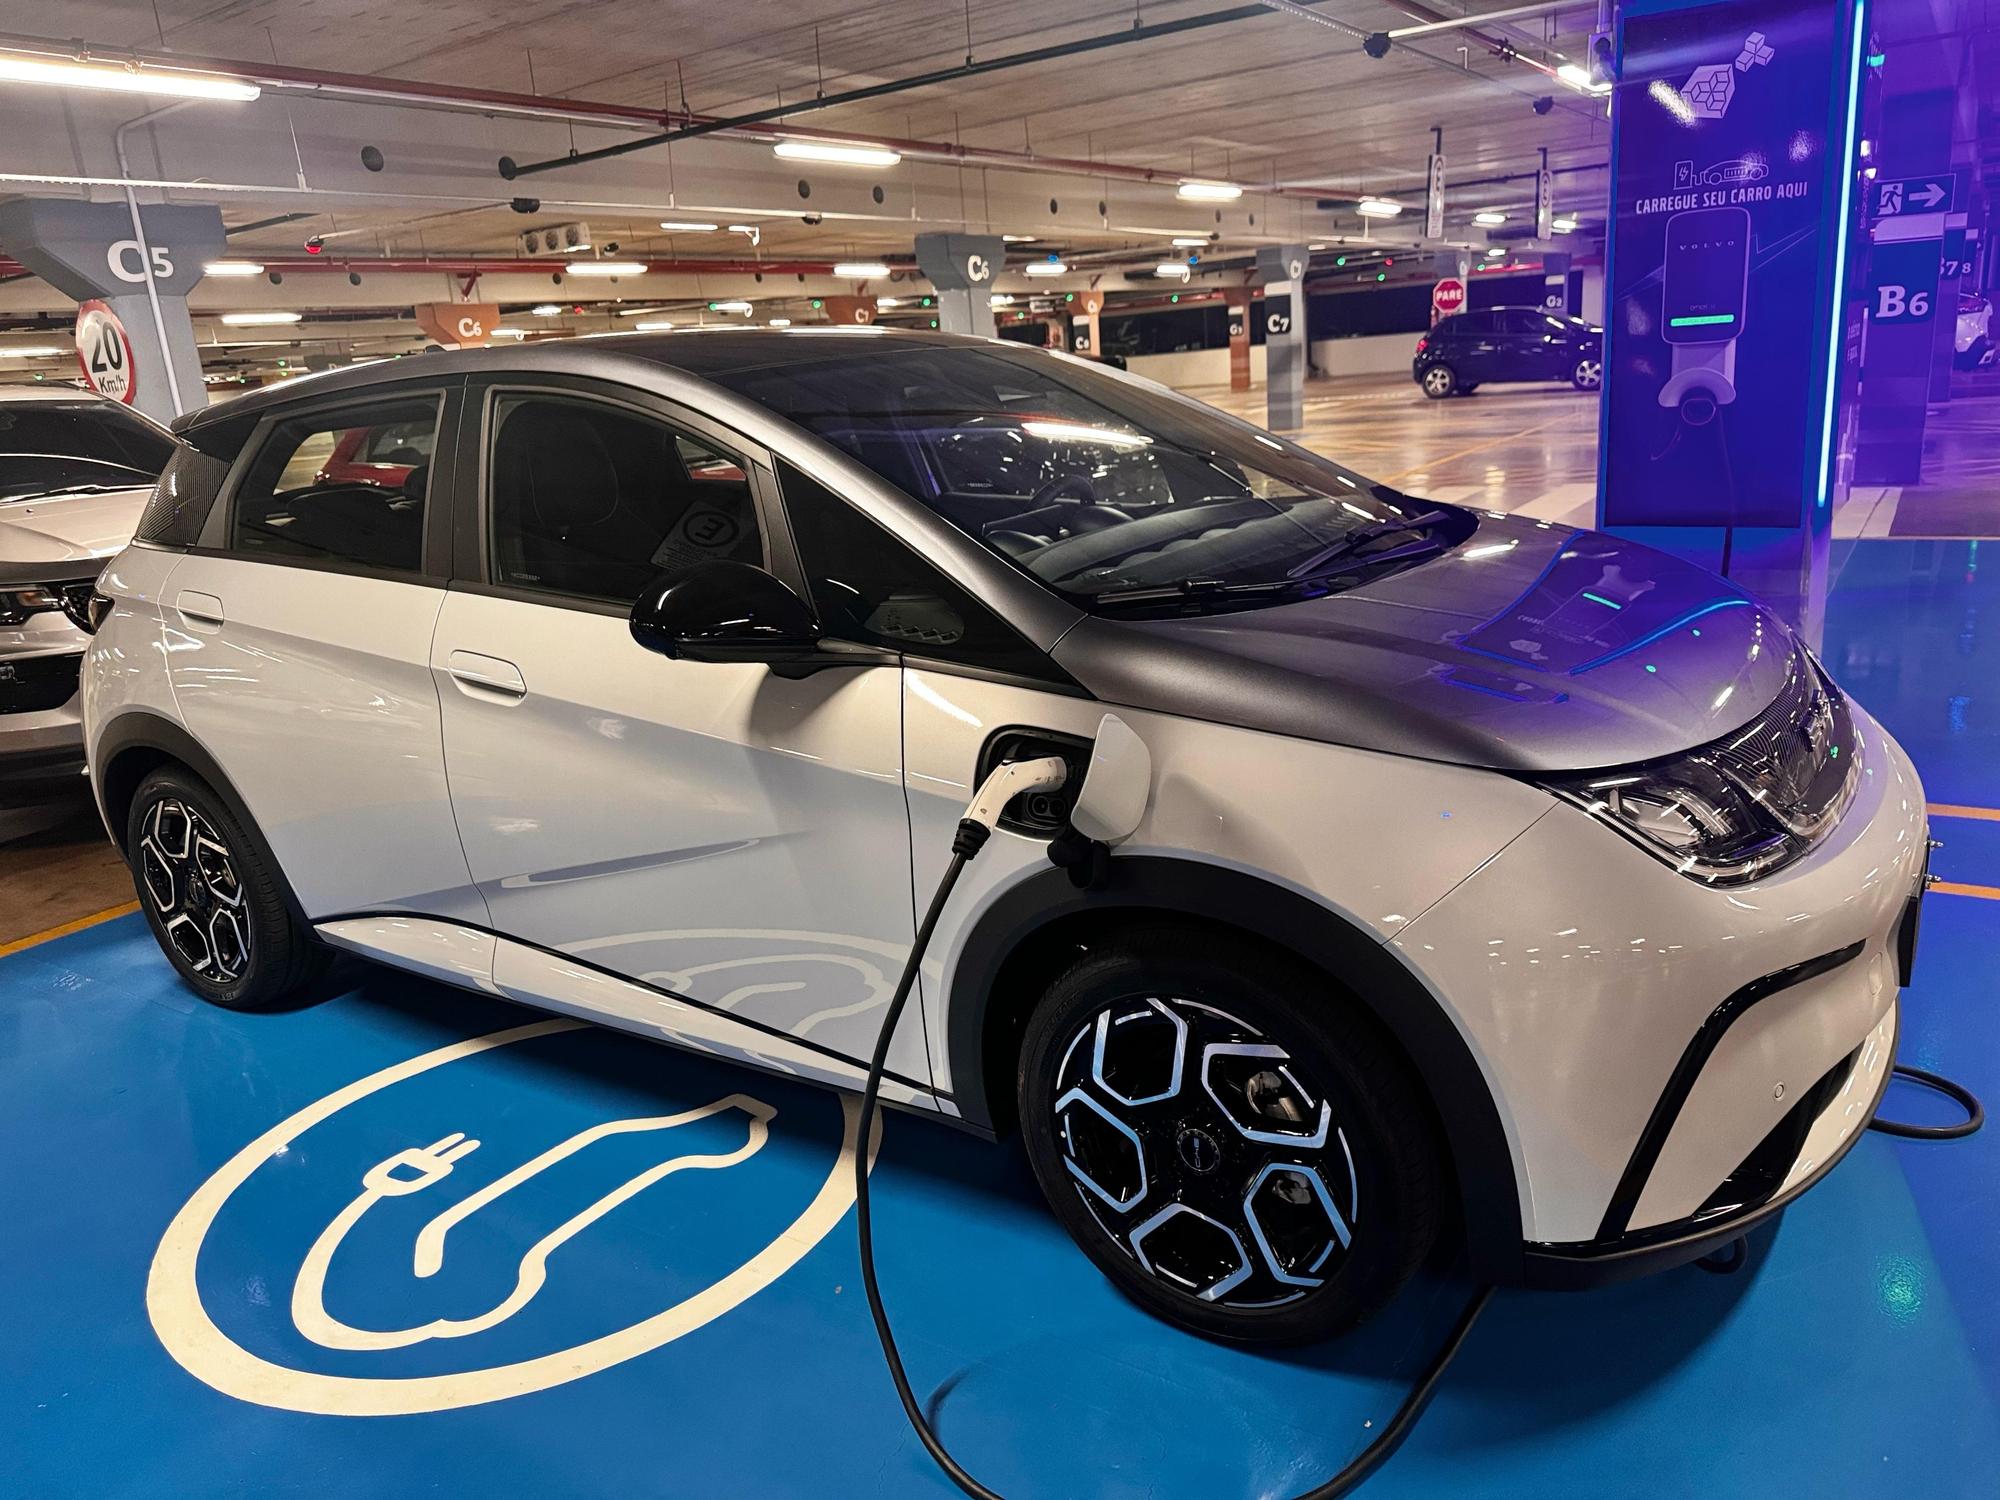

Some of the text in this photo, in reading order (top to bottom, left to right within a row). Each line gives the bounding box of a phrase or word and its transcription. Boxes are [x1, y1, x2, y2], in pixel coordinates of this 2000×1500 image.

[1636, 181, 1808, 215] CARREGUE SEU CARRO AQUI
[1679, 240, 1735, 250] VOLVO
[107, 239, 174, 283] C5
[967, 254, 990, 282] C6
[1436, 288, 1462, 302] PARE
[1875, 285, 1929, 318] B6
[458, 317, 483, 338] C6
[1267, 313, 1290, 333] C7
[90, 318, 123, 374] 20
[98, 375, 127, 394] Km/h
